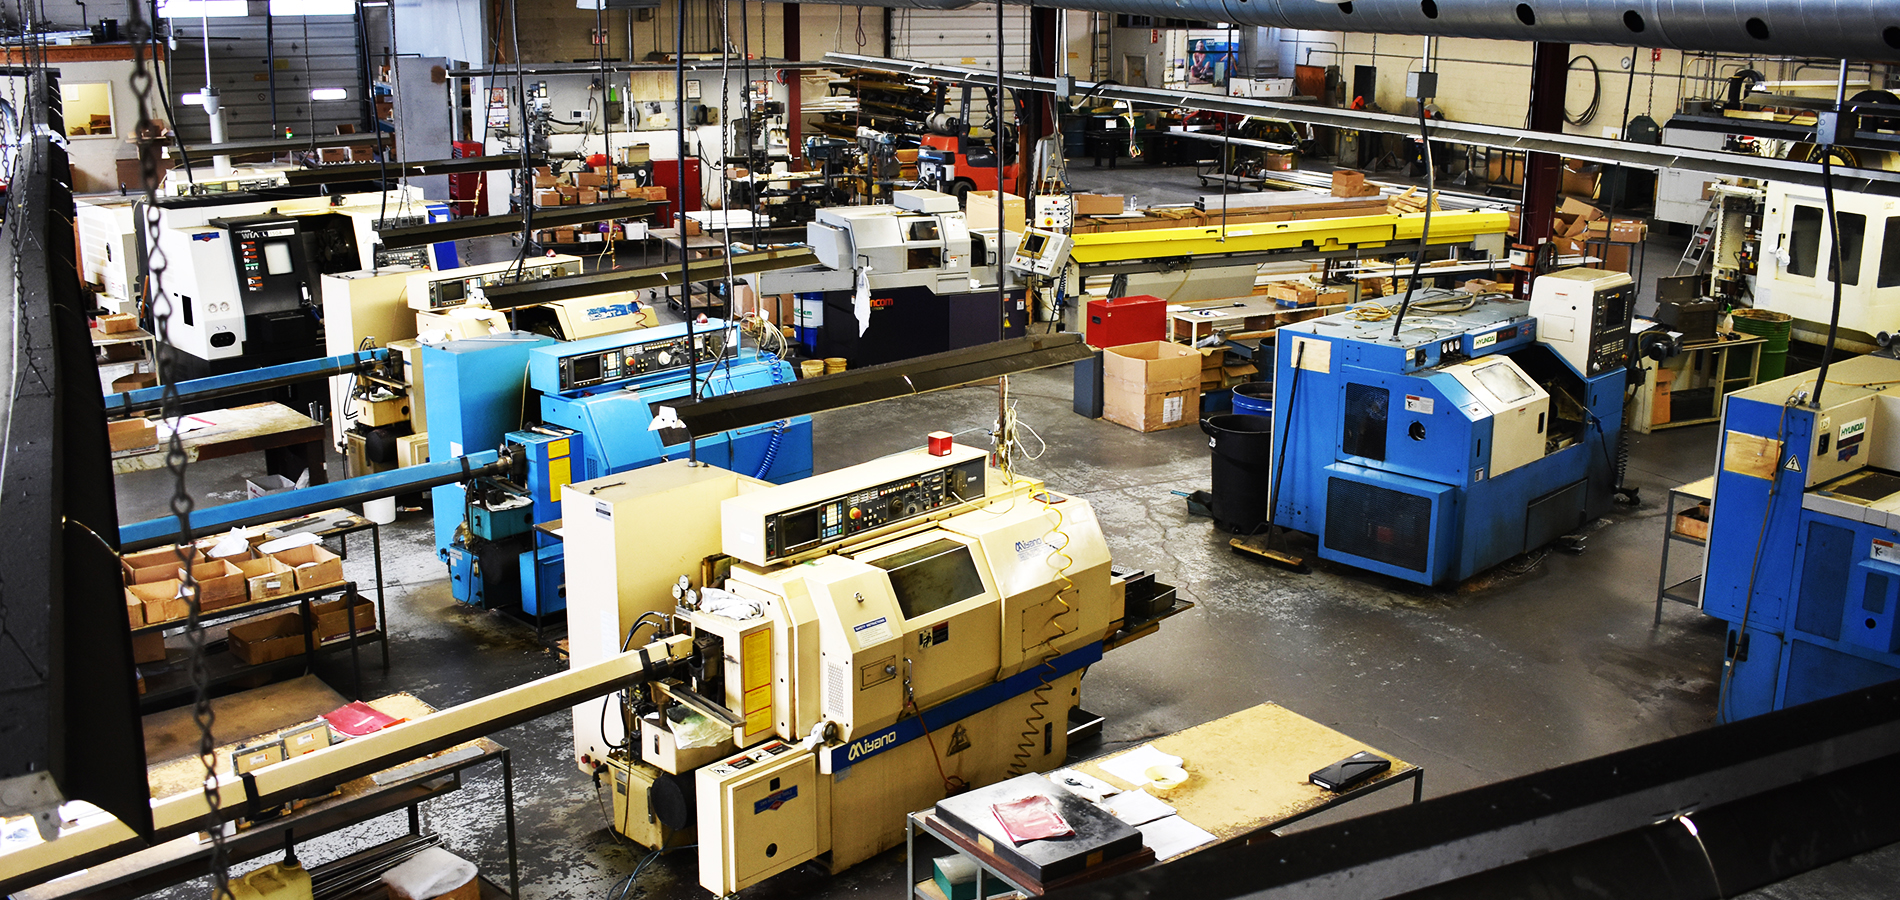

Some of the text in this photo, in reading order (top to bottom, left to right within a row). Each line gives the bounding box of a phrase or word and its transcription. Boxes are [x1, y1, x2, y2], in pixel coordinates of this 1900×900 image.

[870, 298, 893, 308] ncom
[1476, 335, 1495, 345] HYUNDAI
[1841, 422, 1865, 437] HYUNDAI
[1015, 538, 1042, 552] Miyano
[848, 731, 896, 761] Miyano
